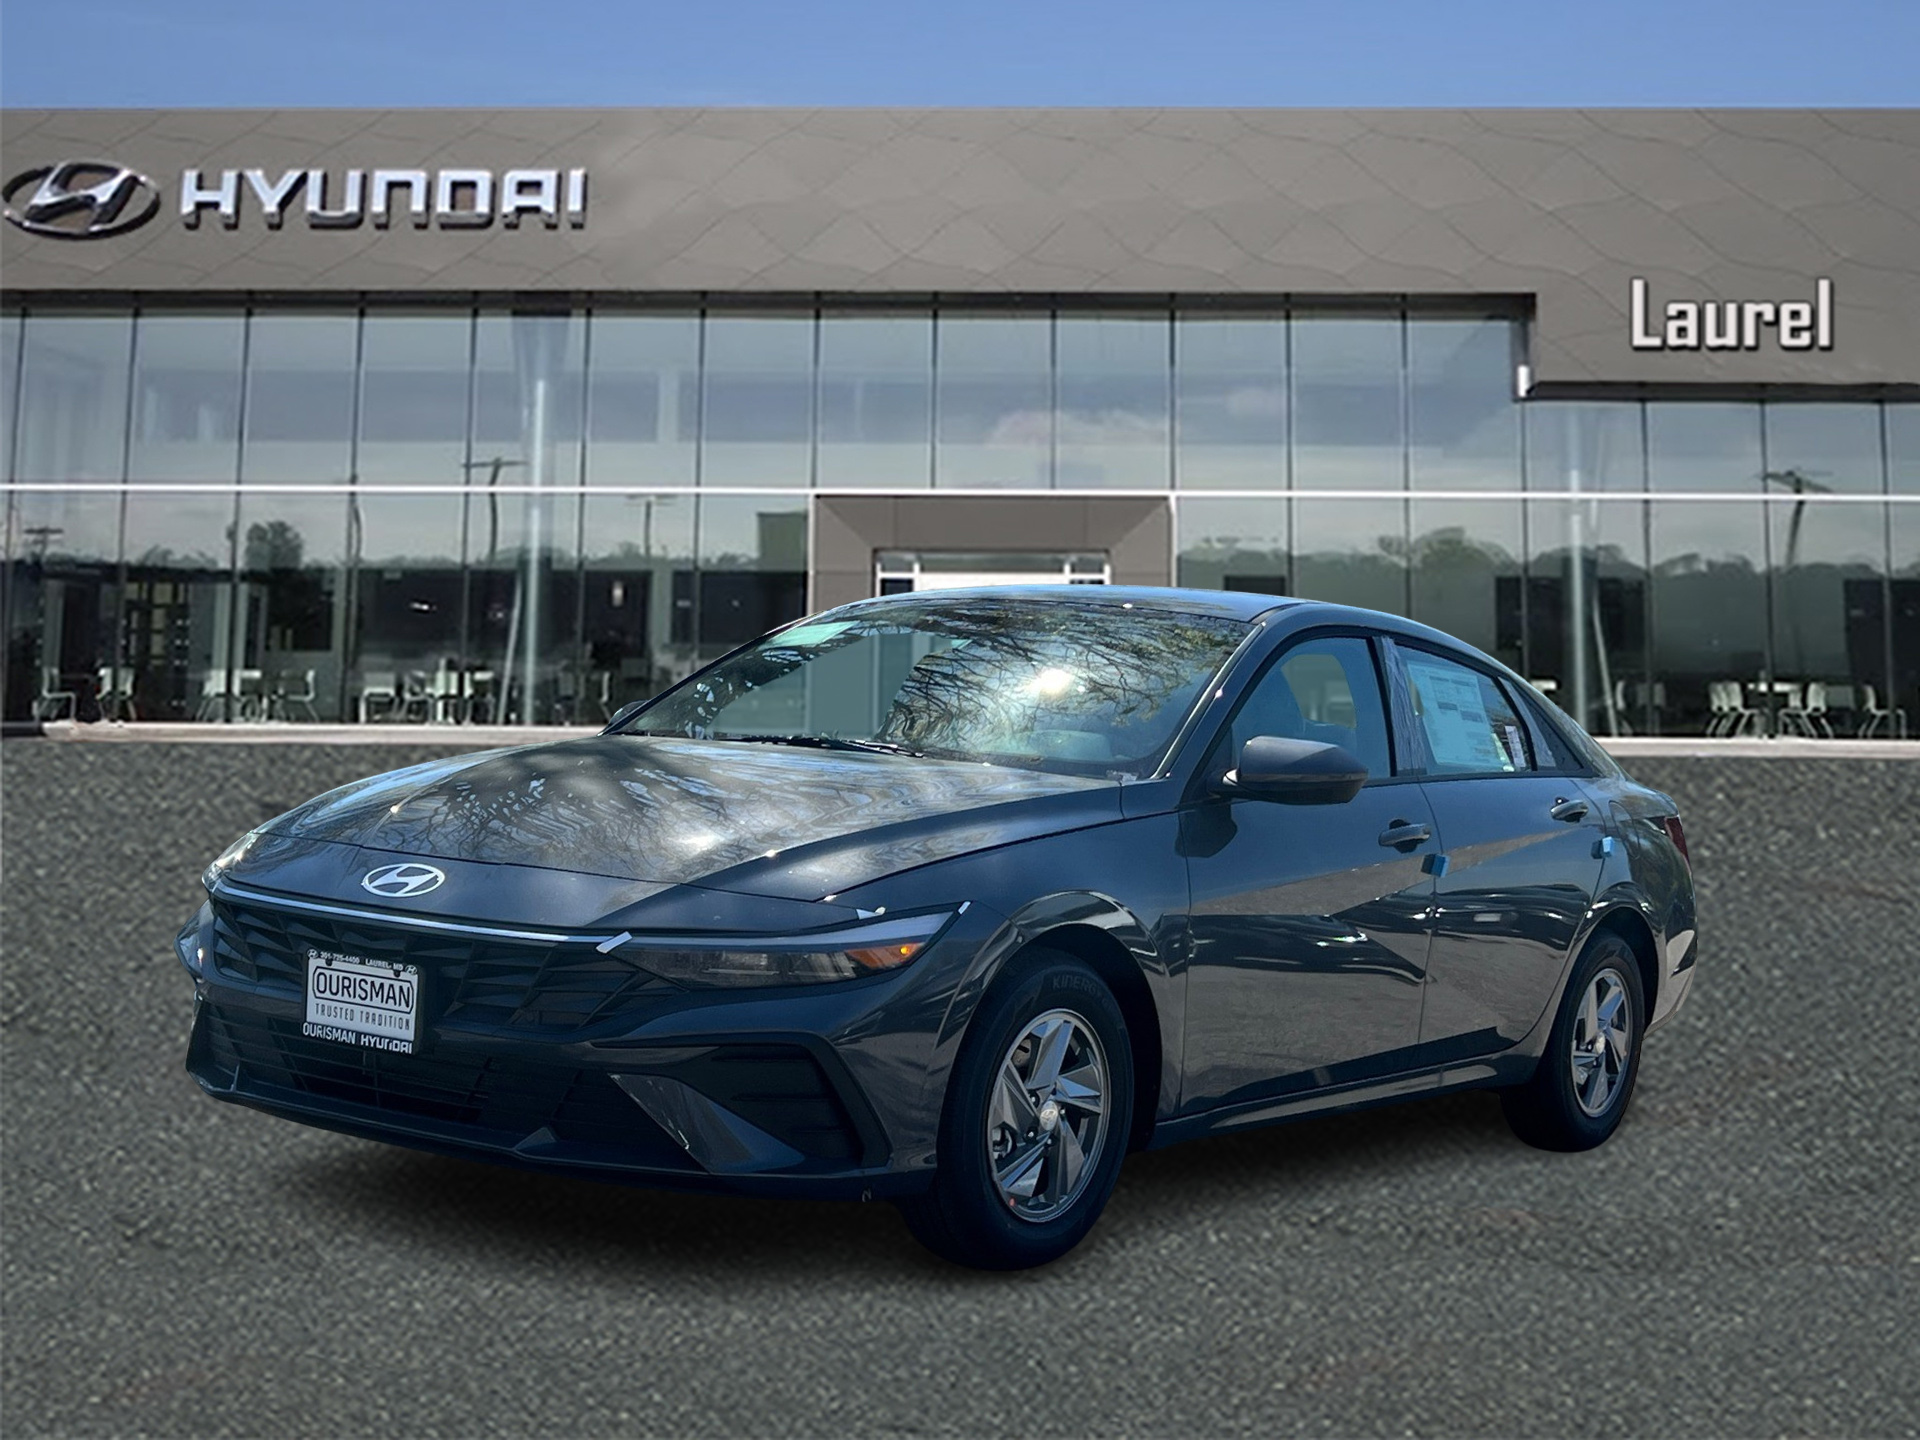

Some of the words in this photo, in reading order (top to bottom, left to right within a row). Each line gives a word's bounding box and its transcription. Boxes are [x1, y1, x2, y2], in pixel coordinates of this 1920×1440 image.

[180, 167, 587, 230] HYUNDAI
[1631, 278, 1832, 349] Laurel
[393, 963, 404, 971] MD
[316, 972, 411, 1008] OURISMAN
[315, 1003, 355, 1021] TRUSTED
[360, 1010, 410, 1030] TRADITION
[302, 1022, 356, 1044] OURISMAN
[360, 1034, 413, 1054] HYUNDAI
